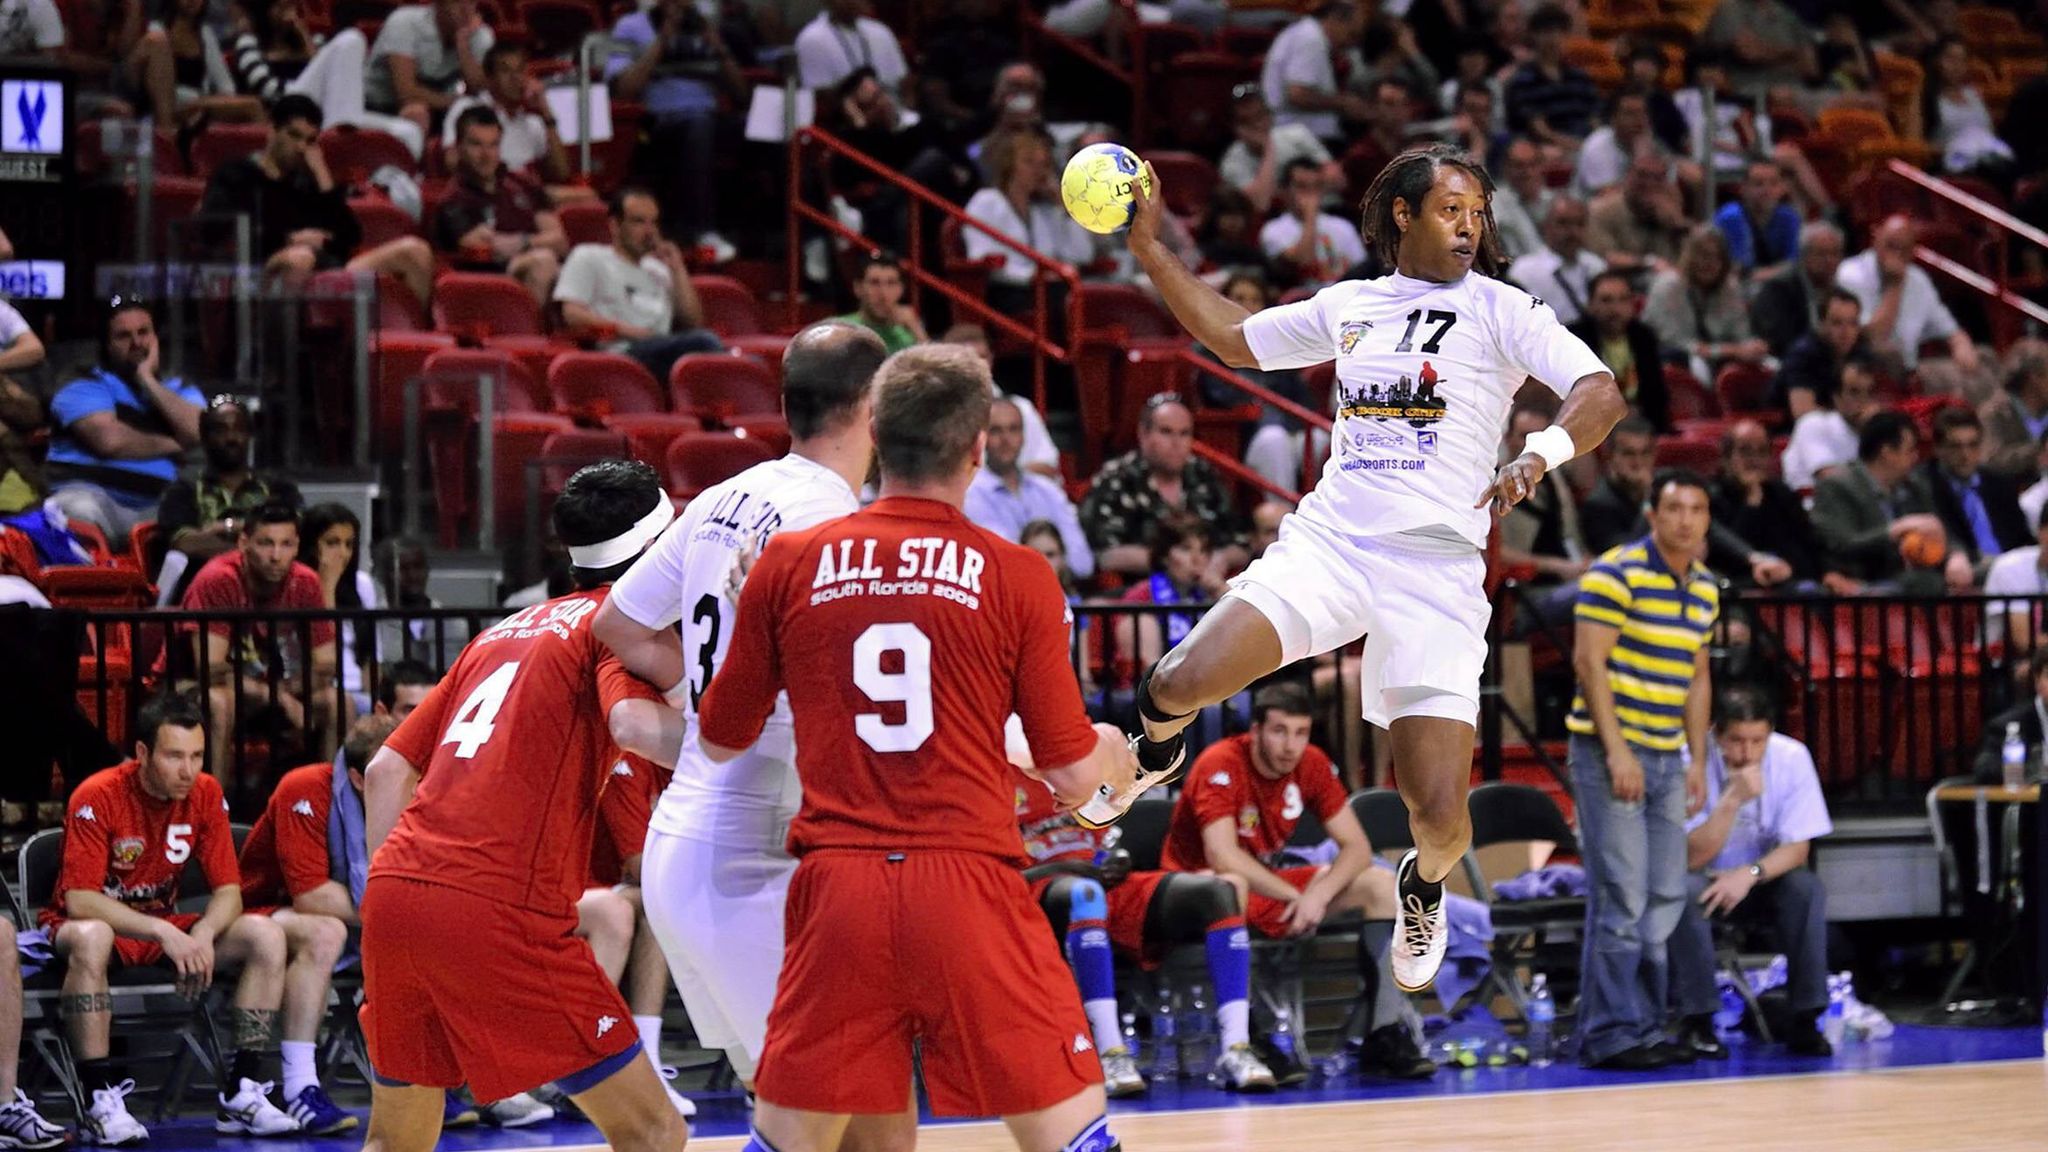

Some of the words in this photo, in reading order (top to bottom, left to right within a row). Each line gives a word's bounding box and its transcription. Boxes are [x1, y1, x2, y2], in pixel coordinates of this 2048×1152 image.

[1395, 309, 1457, 354] 17
[812, 539, 883, 589] ALL
[897, 537, 985, 594] STAR
[932, 583, 979, 610] 2009
[440, 661, 520, 759] 4
[853, 622, 935, 753] 9
[165, 823, 192, 865] 5
